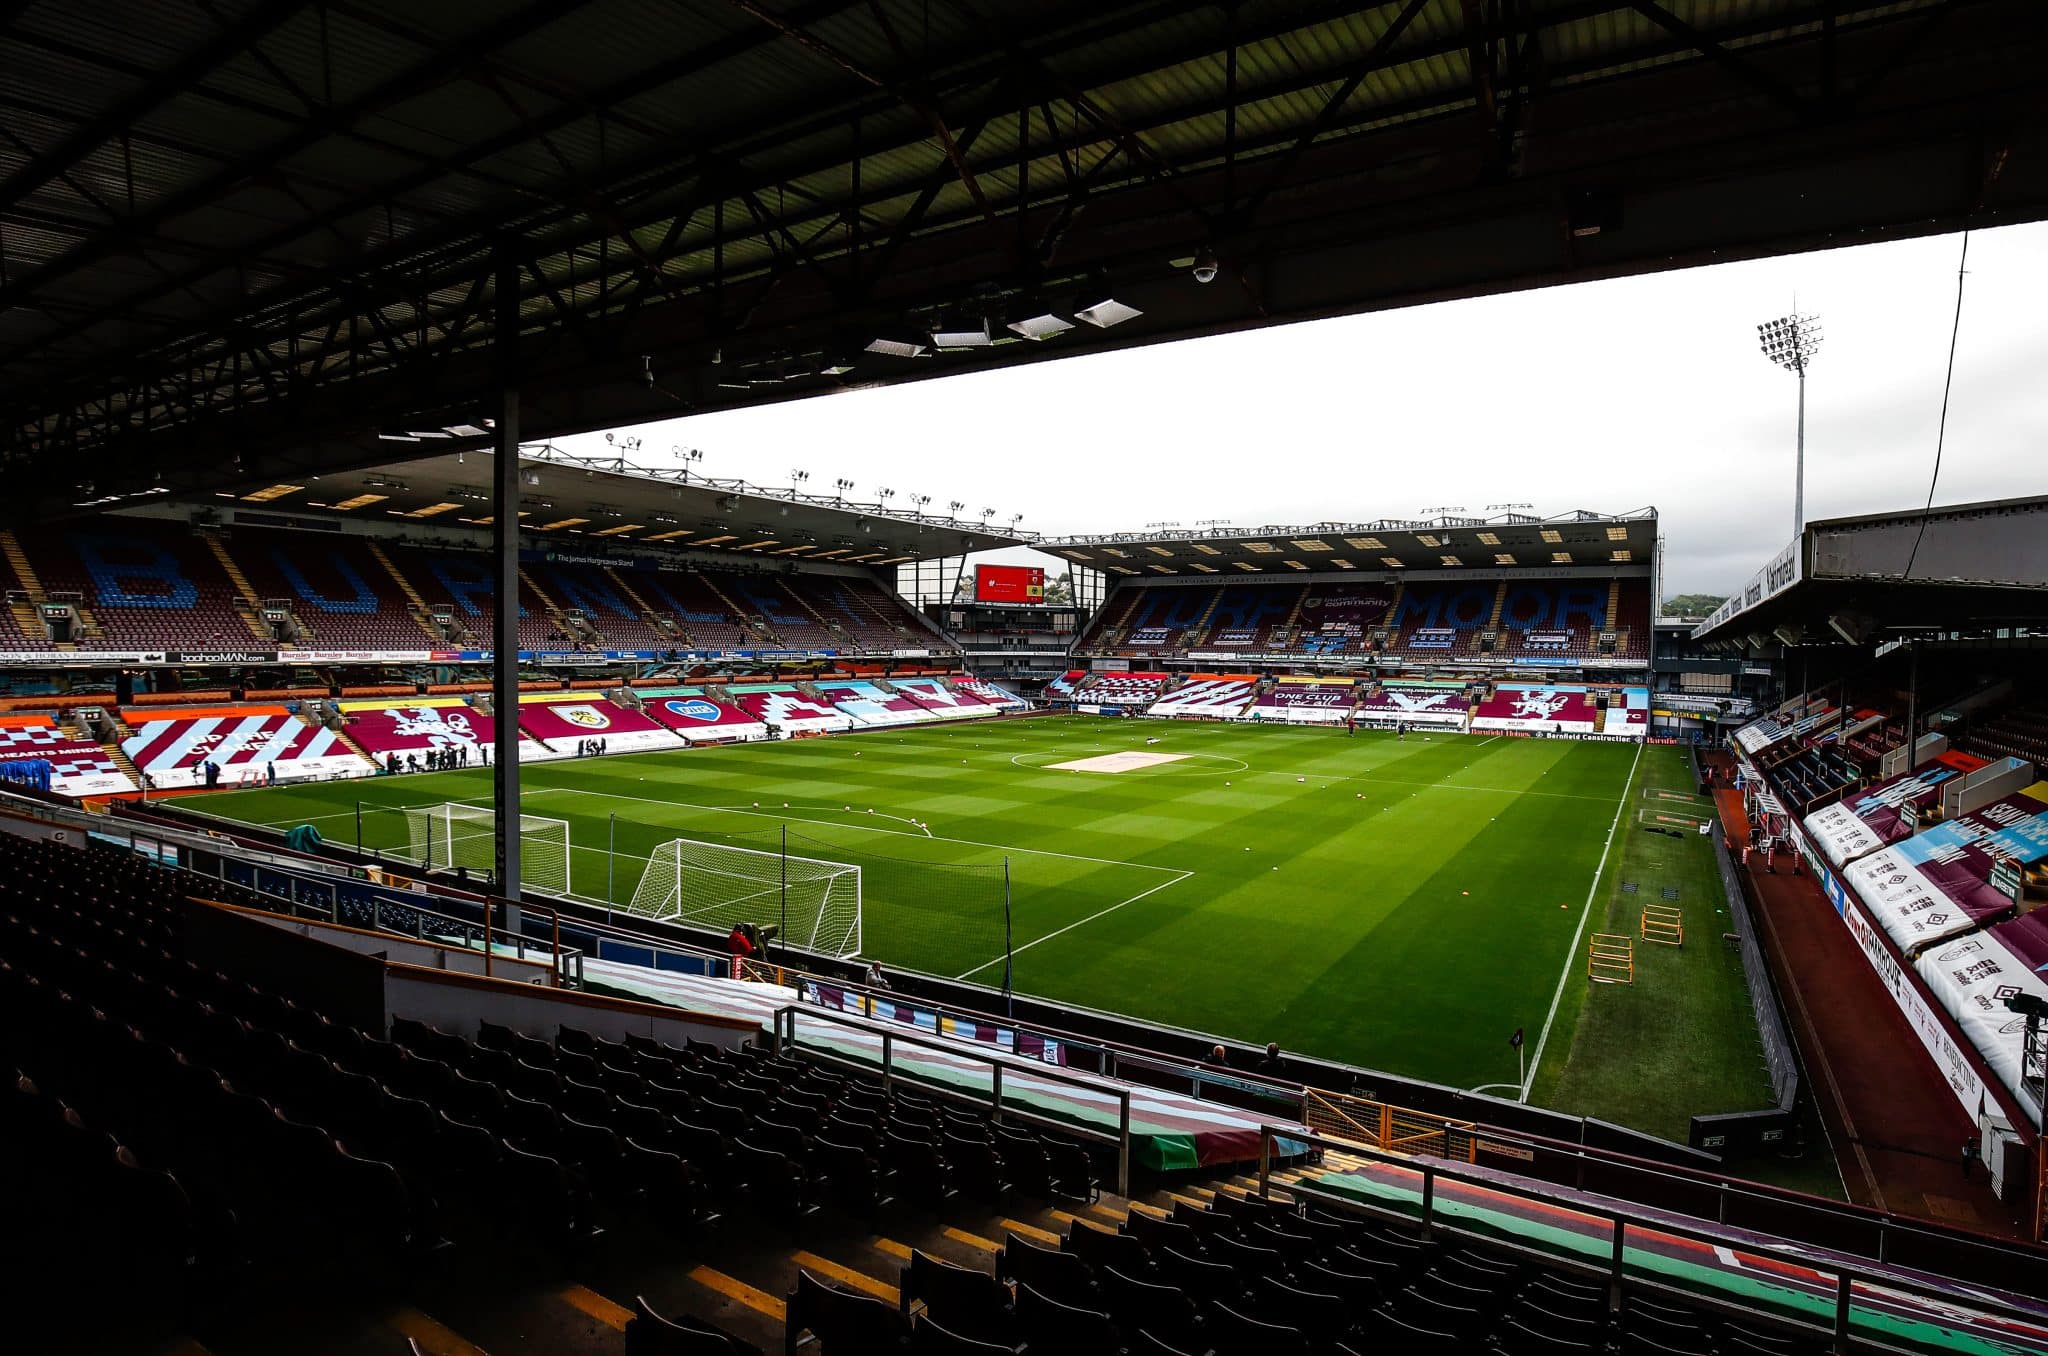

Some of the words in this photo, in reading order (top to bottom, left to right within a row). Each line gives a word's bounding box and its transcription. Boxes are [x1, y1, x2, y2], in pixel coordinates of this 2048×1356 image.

[558, 554, 569, 562] The
[569, 556, 587, 564] James
[587, 557, 617, 567] Hargreaves
[618, 559, 634, 567] Stand
[1135, 591, 1291, 630] TURF
[1324, 599, 1391, 609] community
[1390, 587, 1608, 631] MOOR
[181, 652, 265, 662] boohooMAN.com
[1306, 694, 1342, 702] CLUB
[682, 706, 713, 714] NHS
[190, 734, 223, 744] UP
[226, 730, 276, 740] THE
[1471, 728, 1503, 737] Barnfield
[1547, 731, 1581, 741] Barnfield
[1583, 733, 1631, 743] Construction
[0, 748, 57, 758] HEARTS
[58, 746, 105, 755] MINDS
[187, 741, 299, 755] CLARETS
[1980, 802, 2022, 825] SEAN
[55, 832, 64, 841] C
[1927, 841, 1971, 867] ARMY
[1868, 929, 1902, 999] FARMHOUSE
[1974, 994, 1994, 1011] umbro
[1943, 1036, 1976, 1094] BENEDICTINE
